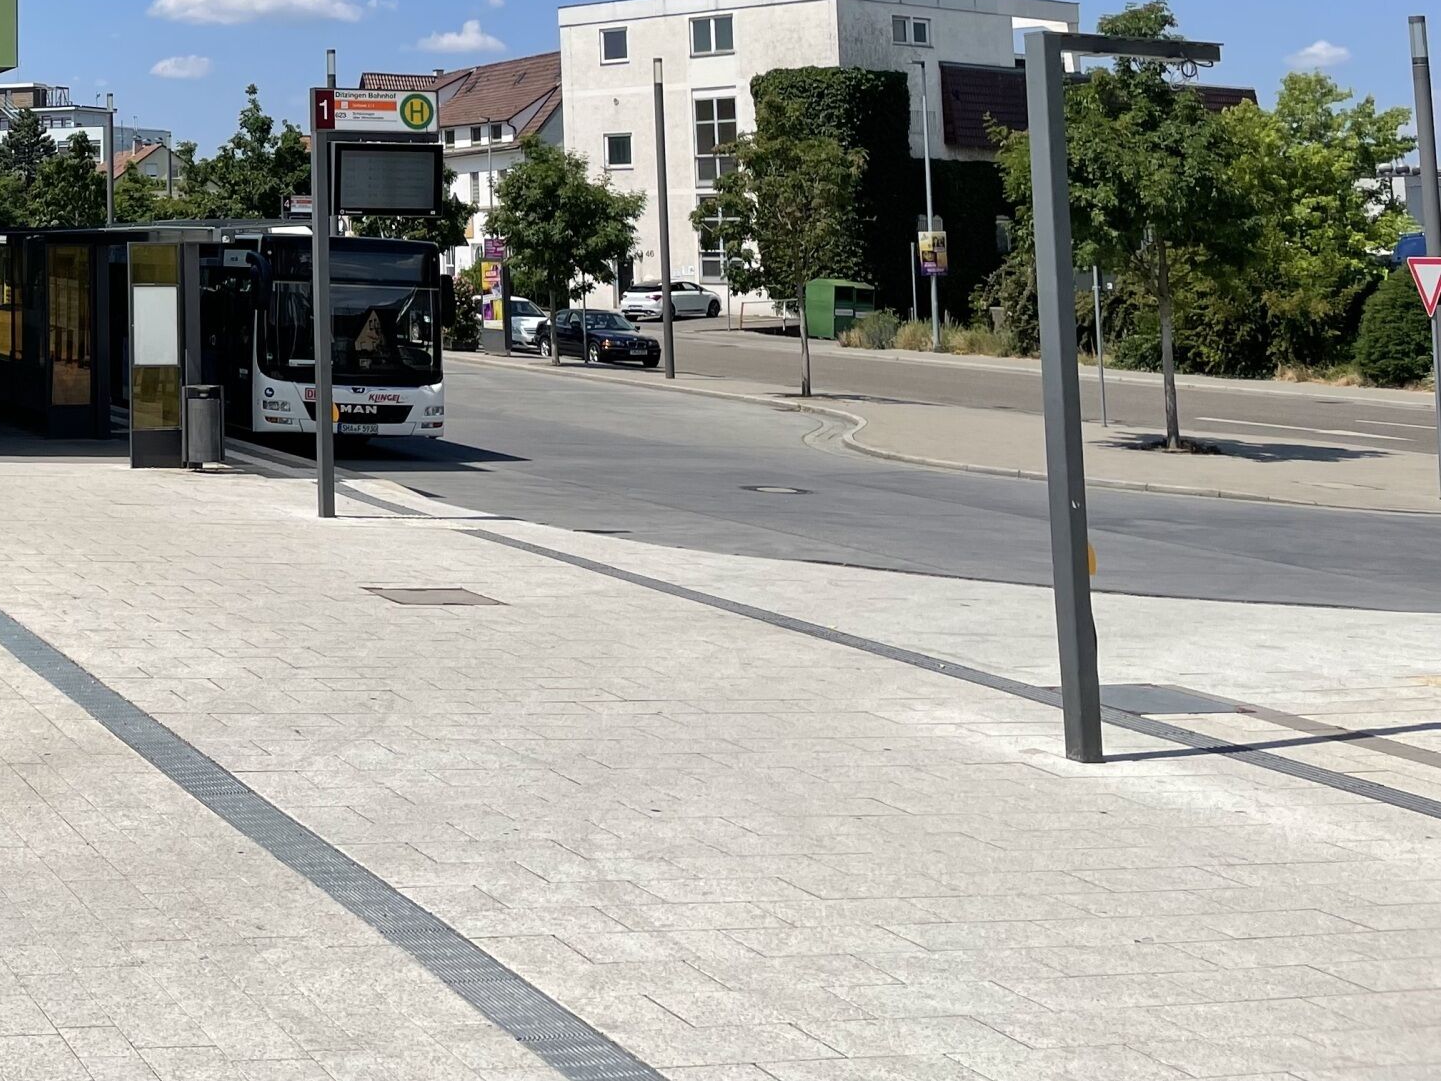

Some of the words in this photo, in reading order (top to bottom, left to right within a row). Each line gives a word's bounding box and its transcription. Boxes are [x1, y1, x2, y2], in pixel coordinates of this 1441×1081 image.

[335, 92, 367, 100] Ditzingen
[319, 99, 328, 120] 1
[410, 101, 424, 122] H
[284, 199, 290, 208] 4
[368, 393, 401, 403] KLINGEL
[340, 404, 378, 415] MAN
